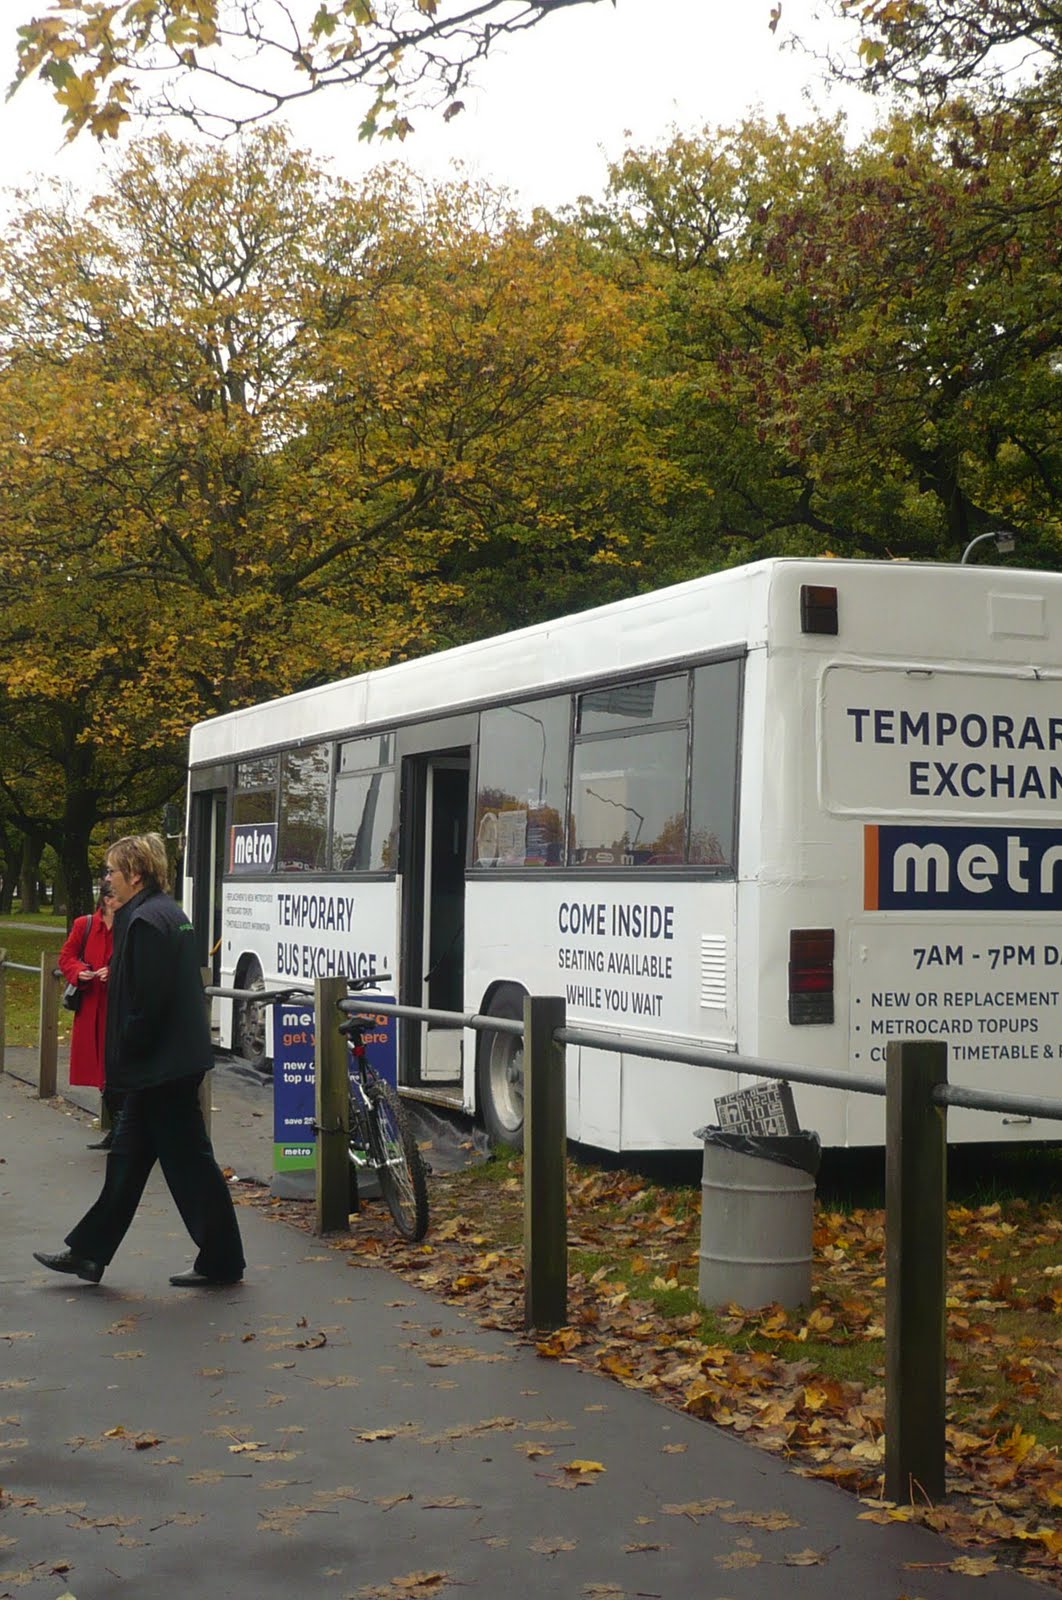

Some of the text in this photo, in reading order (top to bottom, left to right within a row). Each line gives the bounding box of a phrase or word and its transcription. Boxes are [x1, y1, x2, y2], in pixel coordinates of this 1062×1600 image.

[235, 830, 272, 863] metro
[277, 894, 354, 932] TEMPORARY
[558, 902, 674, 939] COME INSIDE
[277, 942, 377, 982] BUS EXCHANGE
[558, 948, 672, 979] SEATING AVAILABLE
[913, 945, 963, 970] 7AM
[988, 945, 1035, 970] 7PM
[566, 984, 663, 1017] WHILE YOU WAIT
[871, 991, 1059, 1007] NEW OR REPLACEMENT
[871, 1018, 1039, 1034] METROCARD TOPUPS
[283, 1031, 307, 1046] get
[952, 1045, 1039, 1060] TIMETABLE
[283, 1061, 307, 1070] new
[283, 1072, 302, 1084] top
[284, 1148, 311, 1156] metro
